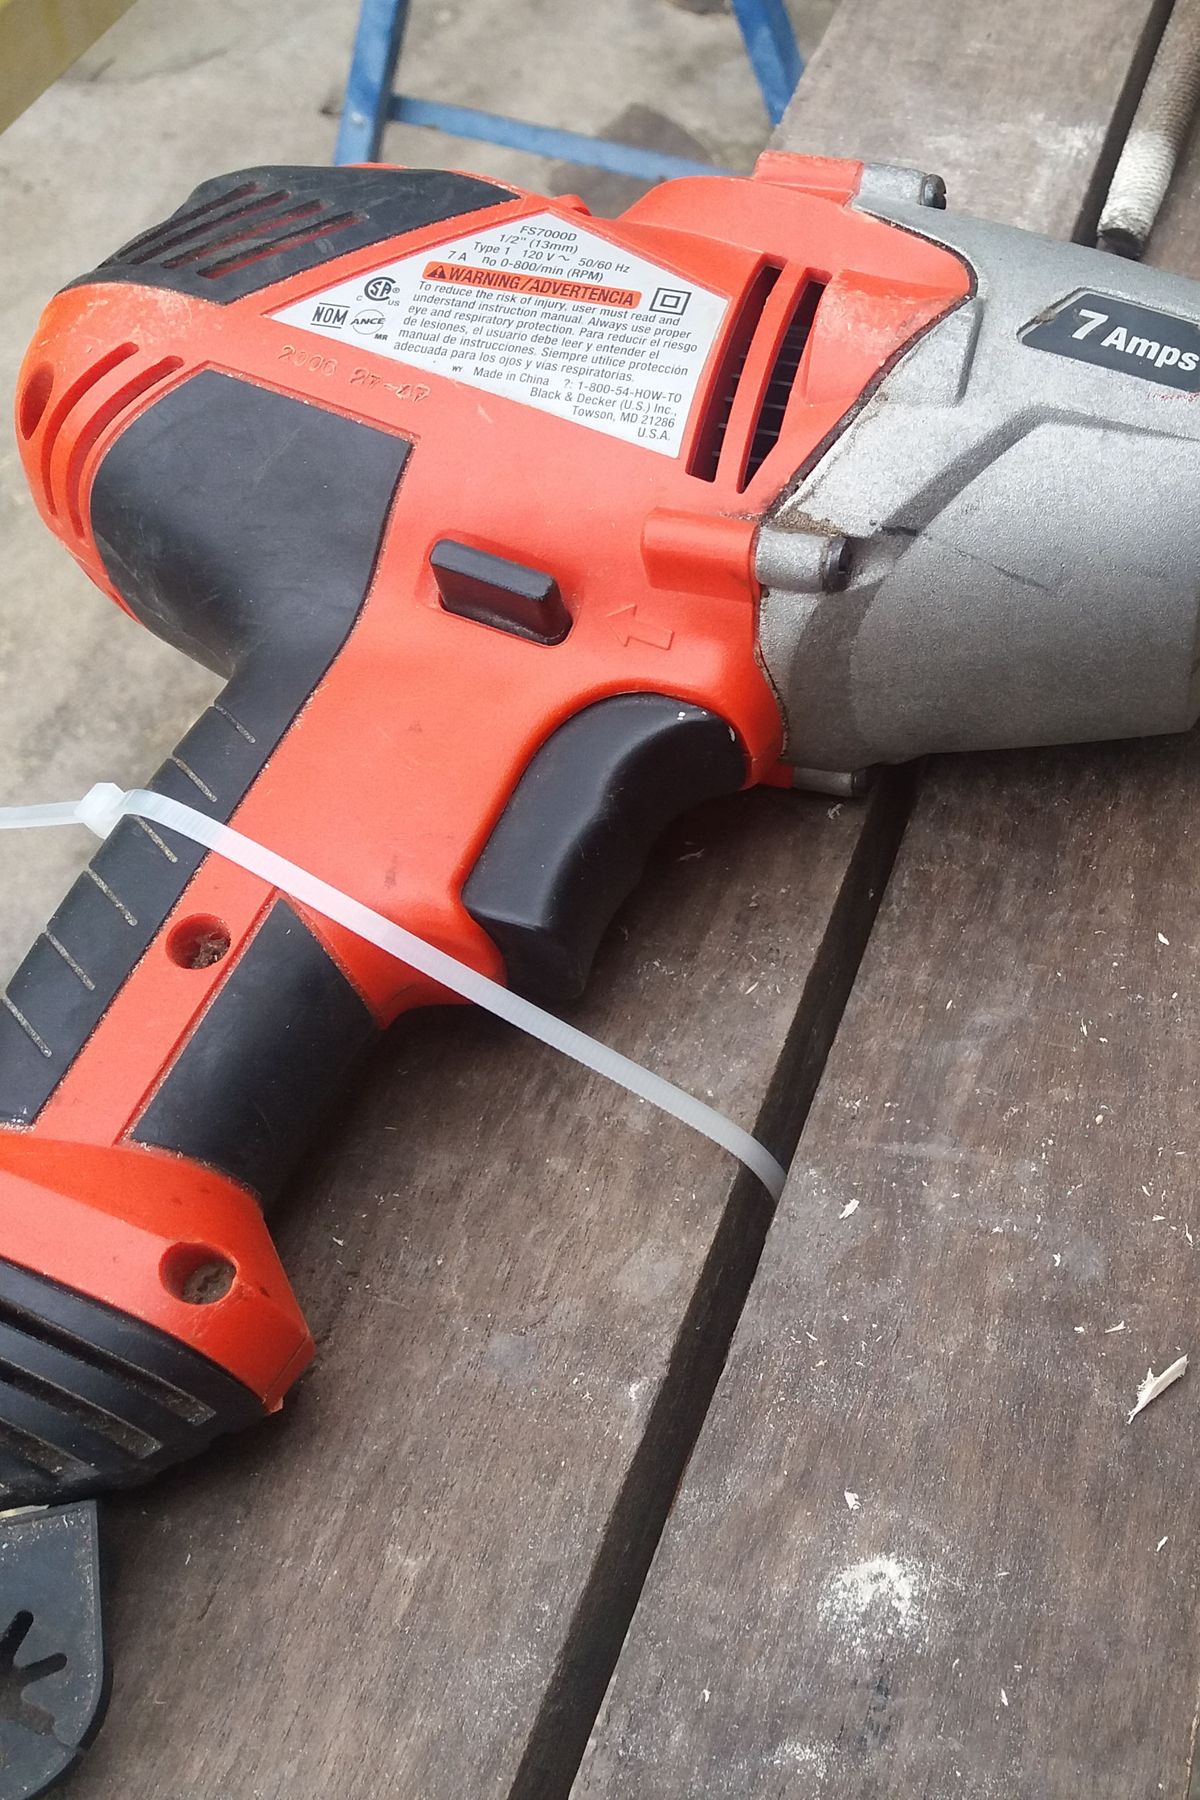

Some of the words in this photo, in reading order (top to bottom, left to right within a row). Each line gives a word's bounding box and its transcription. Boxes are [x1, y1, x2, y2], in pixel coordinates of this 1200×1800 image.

[519, 225, 578, 242] FS7000D
[473, 241, 500, 255] Type
[505, 245, 510, 255] 1
[522, 249, 543, 262] 120
[546, 252, 556, 262] V
[577, 257, 613, 271] 50/60
[615, 263, 630, 274] Hz
[529, 238, 579, 254] (13mm)
[448, 250, 456, 259] 7
[457, 251, 468, 261] A
[500, 258, 564, 276] 0-800/min
[566, 267, 604, 283] (RPM)
[387, 299, 400, 307] US
[418, 280, 432, 292] To
[434, 283, 473, 297] reduce
[475, 288, 494, 300] the
[495, 291, 517, 303] risk
[519, 294, 533, 305] of
[571, 304, 597, 315] user
[599, 306, 628, 319] must
[630, 311, 657, 323] read
[658, 314, 681, 326] and
[311, 306, 349, 326] NOM
[350, 317, 387, 326] ANCE
[412, 293, 477, 310] understand
[477, 300, 538, 318] instruction
[540, 311, 584, 325] manual.
[587, 316, 628, 331] Always
[630, 323, 652, 334] use
[653, 327, 692, 340] proper
[374, 333, 389, 341] MR
[402, 315, 418, 327] de
[420, 318, 469, 335] lesiones,
[472, 325, 484, 336] el
[485, 327, 528, 342] usuario
[530, 333, 559, 346] debe
[560, 336, 584, 349] leer
[585, 341, 593, 352] y
[595, 343, 647, 360] entender
[648, 348, 660, 360] el
[407, 304, 428, 316] eye
[430, 306, 451, 319] and
[453, 310, 514, 328] respiratory
[515, 319, 575, 336] protection.
[578, 327, 604, 340] Para
[606, 331, 648, 346] reducir
[649, 336, 660, 347] el
[662, 338, 698, 353] riesgo
[1071, 308, 1109, 341] 7
[1100, 326, 1200, 372] Amps
[398, 328, 441, 343] manual
[442, 333, 457, 345] de
[459, 335, 538, 357] instrucciones.
[541, 346, 589, 364] Siempre
[590, 352, 626, 368] utilice
[393, 339, 448, 357] adecuada
[449, 349, 476, 361] para
[478, 351, 497, 363] los
[498, 354, 522, 368] ojos
[524, 359, 533, 369] y
[560, 362, 635, 383] respiratorias.
[451, 364, 464, 374] WY
[473, 366, 503, 381] Made
[505, 370, 516, 382] in
[519, 372, 550, 387] China
[529, 386, 561, 401] Black
[563, 391, 573, 402] &
[576, 393, 616, 409] Decker
[619, 400, 651, 414] (U.S.)
[577, 381, 683, 404] 1-800-54-HOW-TO
[572, 405, 616, 423] Towson,
[619, 411, 639, 424] MD
[640, 414, 676, 428] 21286
[637, 429, 671, 442] U.S.A.
